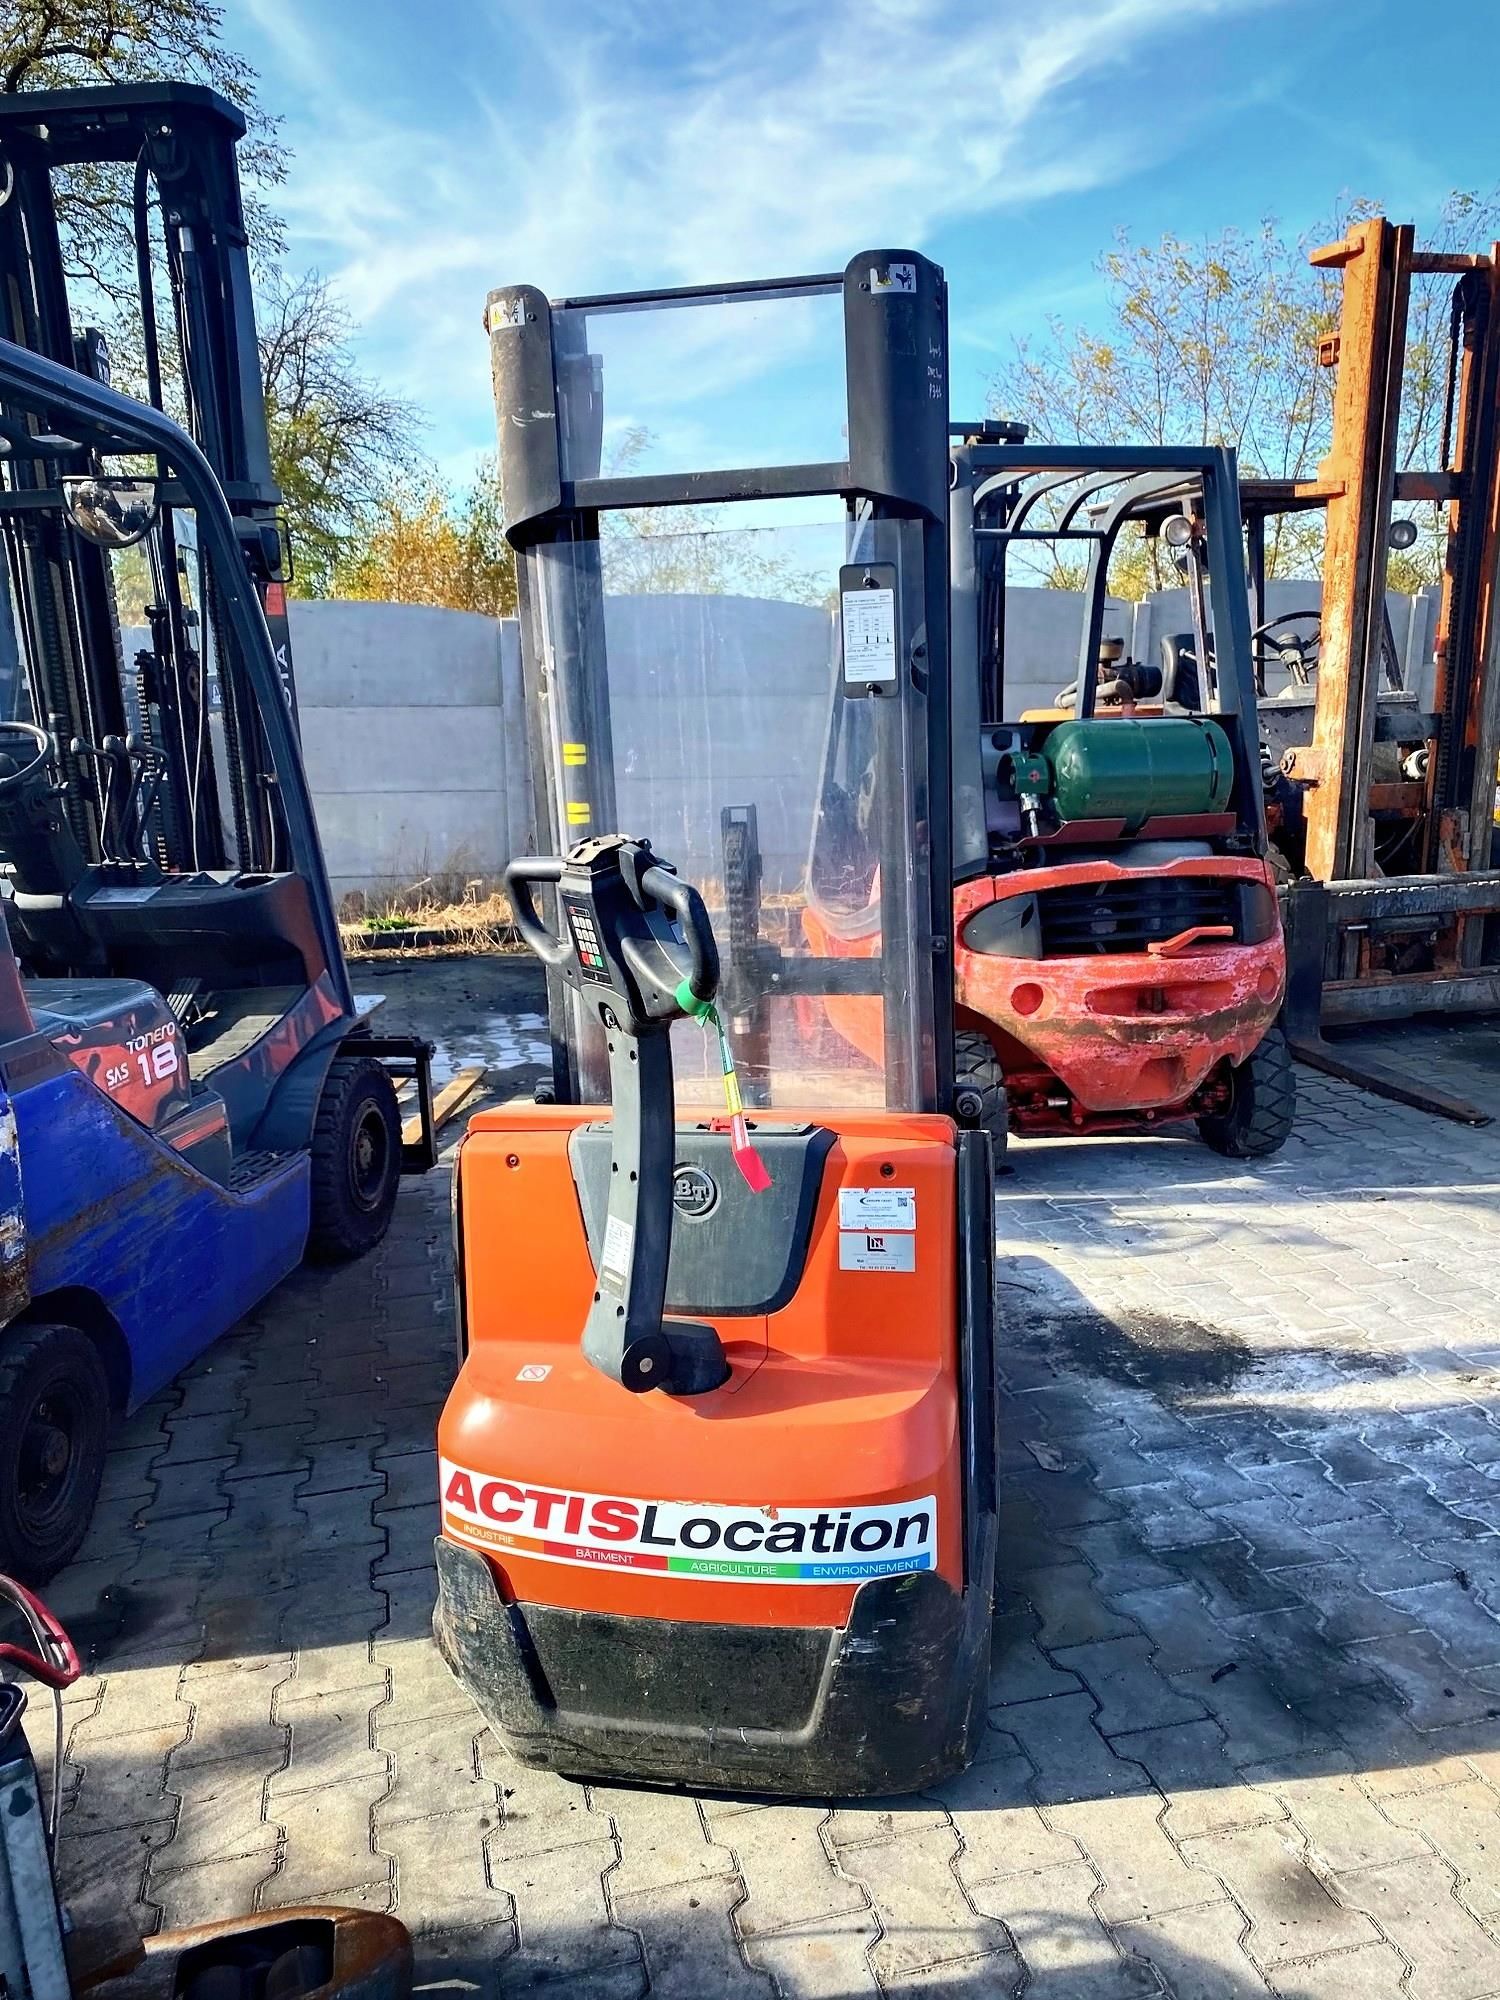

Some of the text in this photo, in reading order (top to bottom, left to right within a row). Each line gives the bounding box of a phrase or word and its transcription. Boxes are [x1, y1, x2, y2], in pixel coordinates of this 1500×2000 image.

[106, 1062, 130, 1087] SAS
[137, 1041, 178, 1086] 18
[676, 1179, 707, 1202] BT
[445, 1470, 930, 1553] ACTIS Location
[463, 1523, 920, 1576] INDUSTRIE BÂTIMENT AGRICULTURE ENVIRONNEMENT
